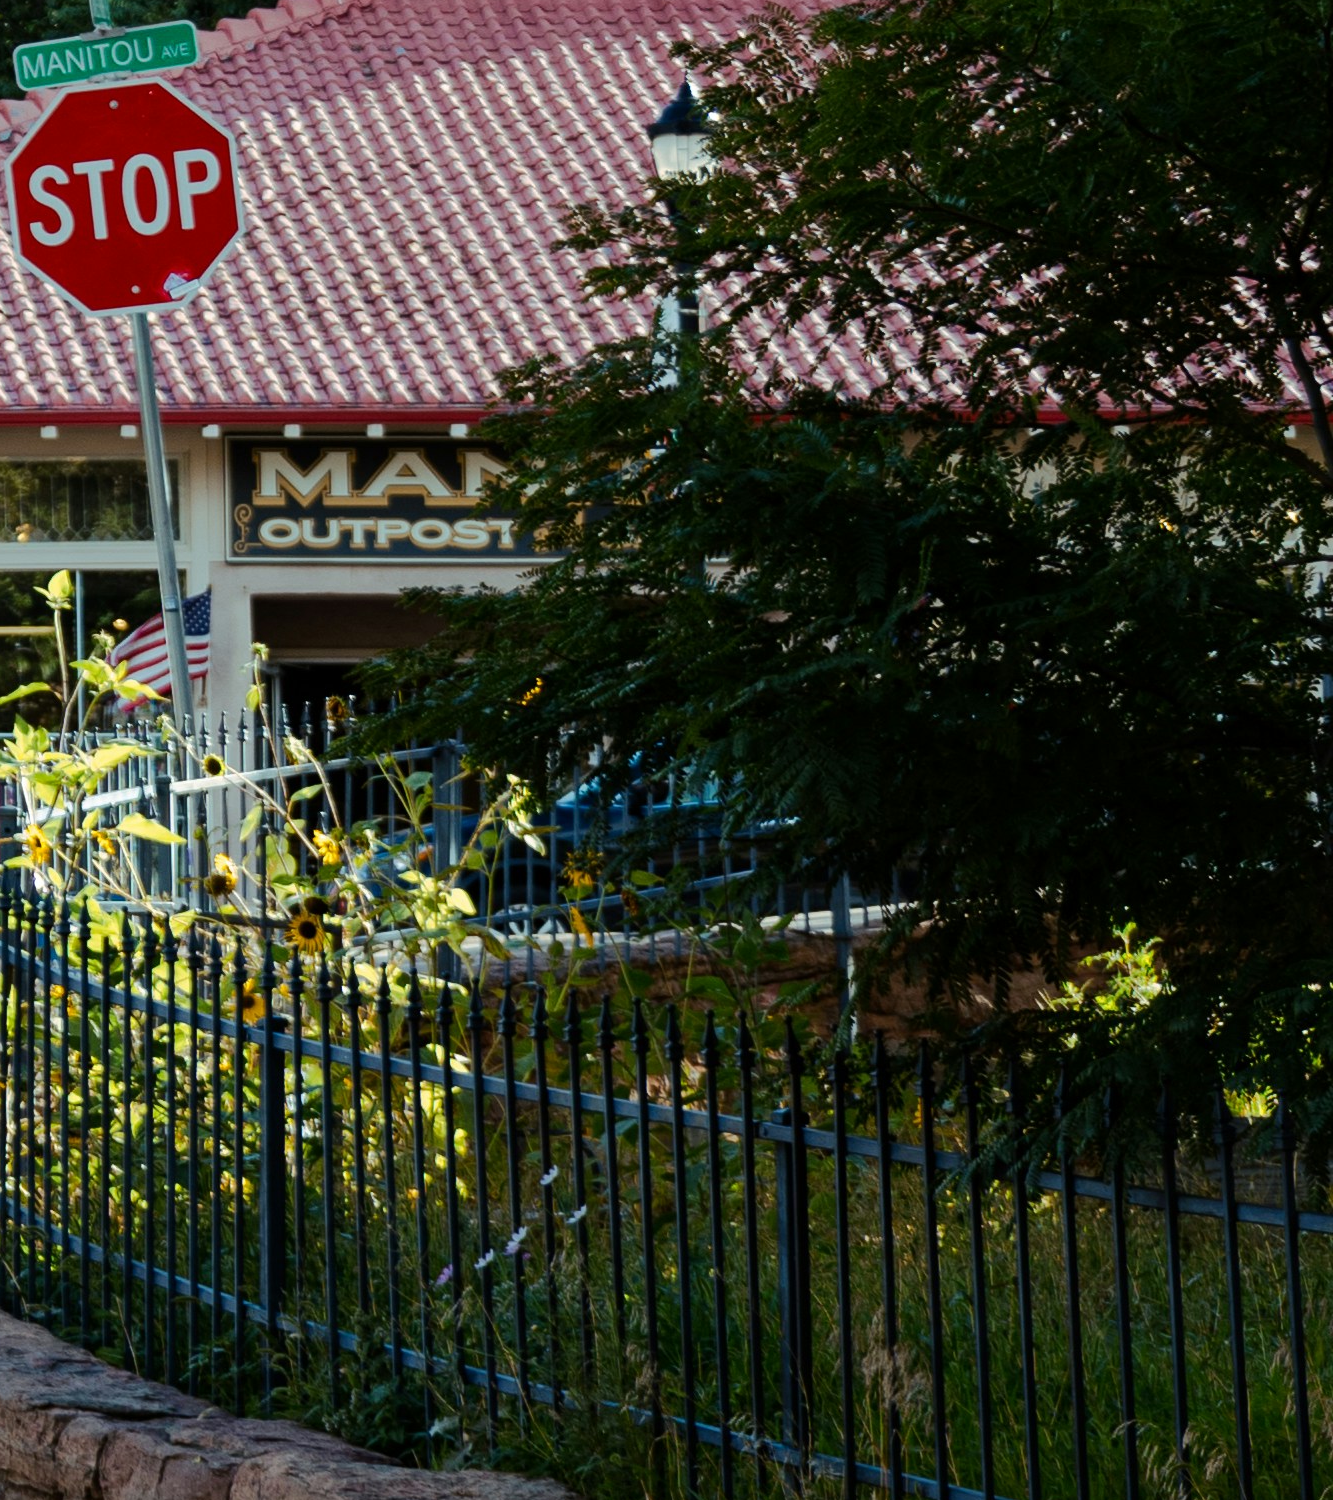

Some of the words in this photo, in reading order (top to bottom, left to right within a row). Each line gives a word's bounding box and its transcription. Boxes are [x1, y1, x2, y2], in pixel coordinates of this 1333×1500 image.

[21, 36, 154, 80] MANITOU
[160, 42, 190, 60] AVE
[28, 148, 222, 248] STOP
[257, 516, 516, 550] OUTPOST
